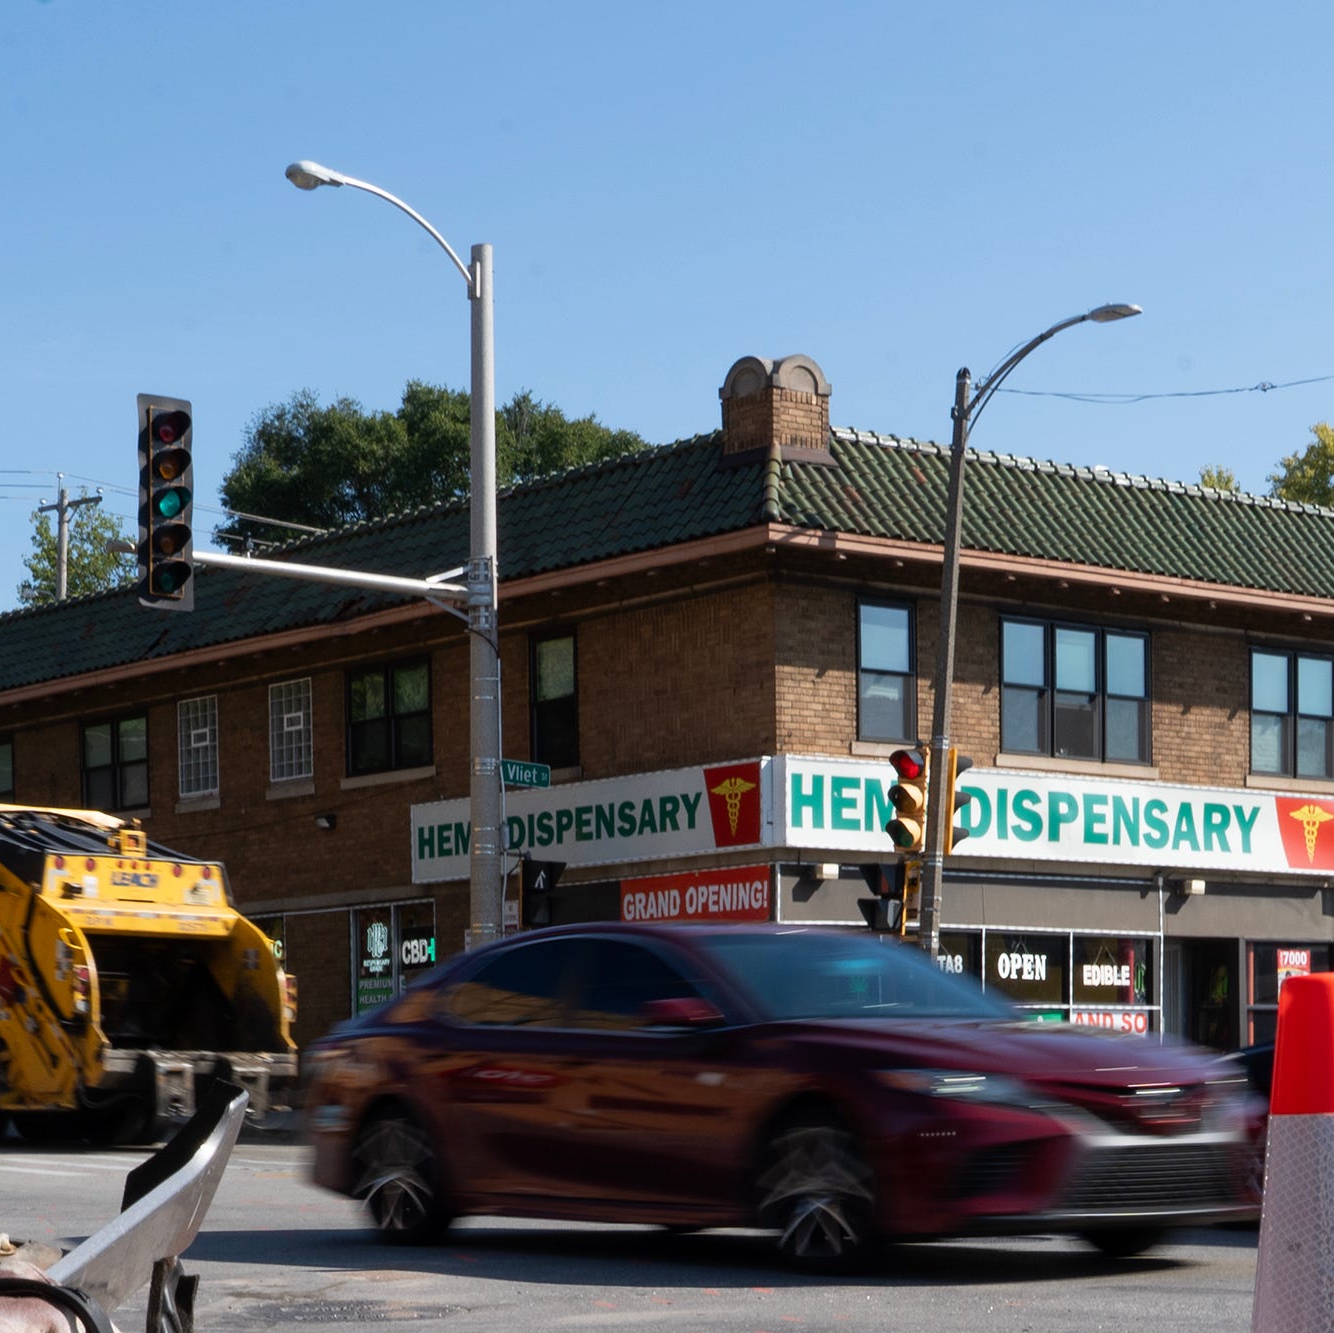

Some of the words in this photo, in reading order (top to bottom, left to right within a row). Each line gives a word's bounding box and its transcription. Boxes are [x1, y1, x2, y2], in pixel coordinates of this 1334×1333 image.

[507, 763, 538, 783] Vliet
[418, 821, 471, 860] HEM
[507, 791, 702, 850] DISPENSARY
[791, 773, 899, 832] HEM
[960, 786, 1261, 853] DISPENSARY
[623, 889, 680, 921] GRAND
[685, 880, 768, 915] OPENING!
[937, 954, 964, 974] TA8
[997, 952, 1047, 981] OPEN
[1083, 964, 1130, 987] EDIBLE
[1074, 1012, 1114, 1029] AND
